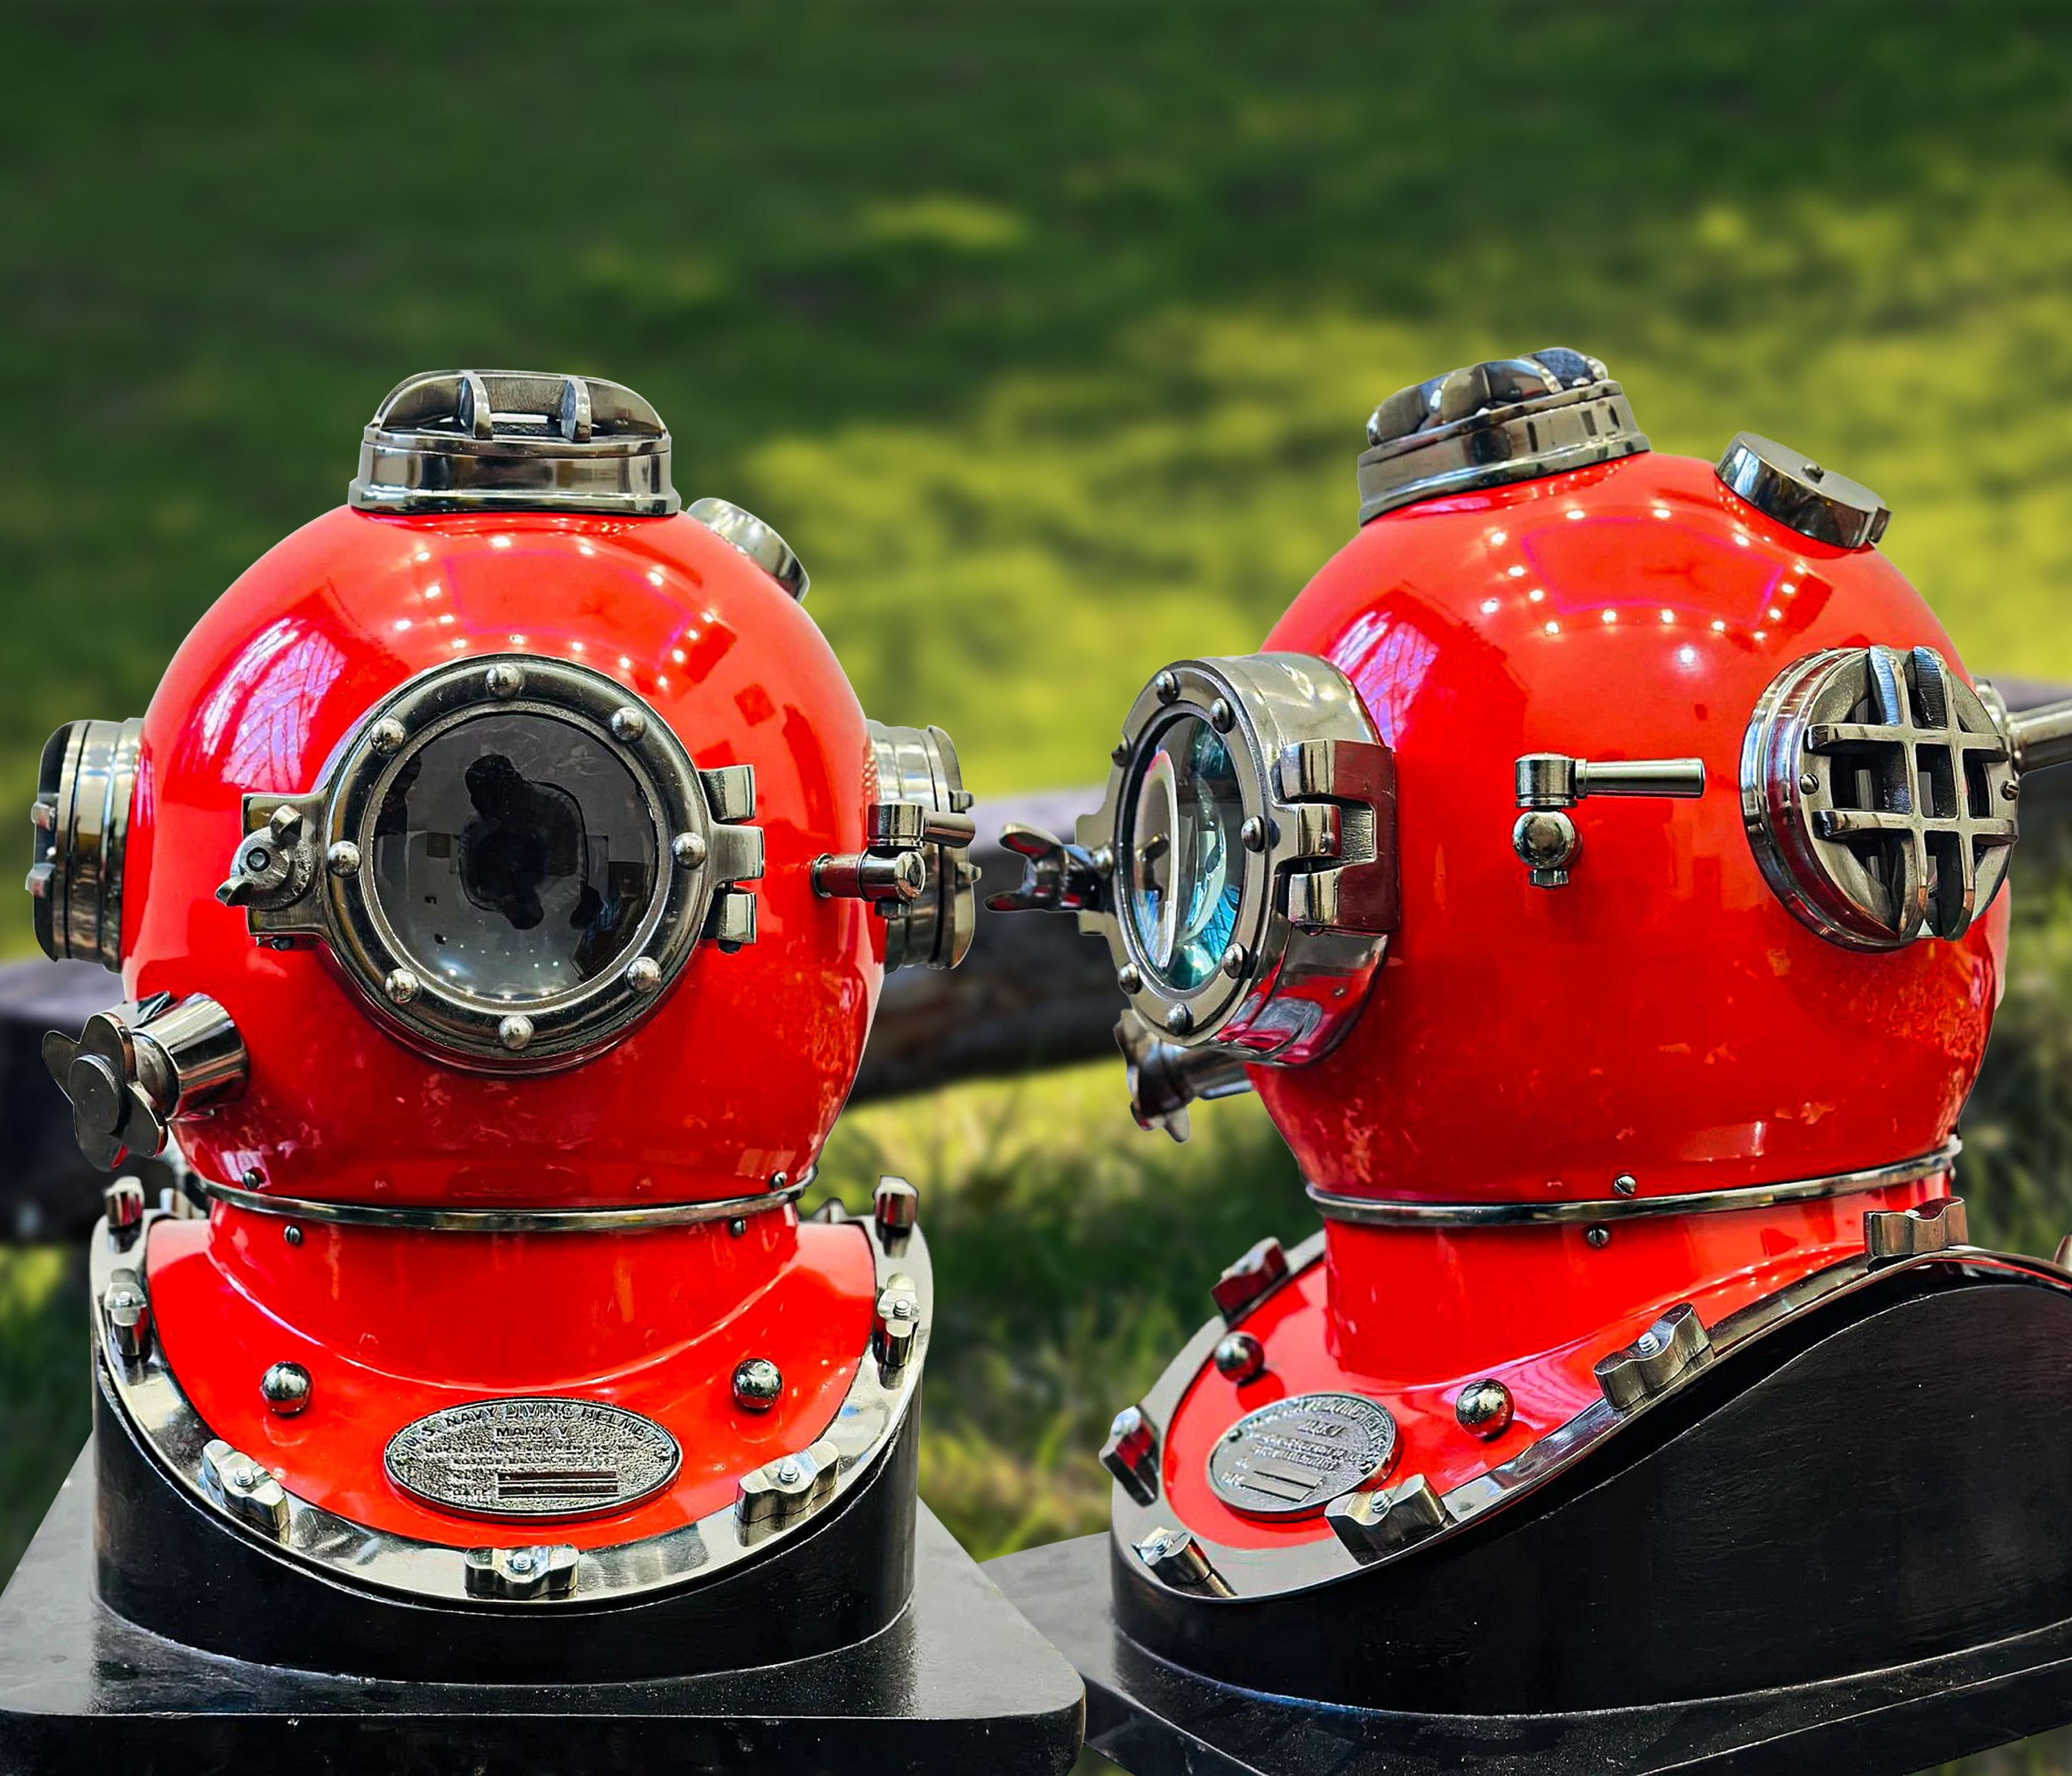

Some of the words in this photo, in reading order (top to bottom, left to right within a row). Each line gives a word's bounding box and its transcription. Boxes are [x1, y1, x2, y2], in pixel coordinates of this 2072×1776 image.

[444, 1406, 495, 1428] NAVY
[506, 1403, 574, 1420] DIVING
[579, 1406, 662, 1447] HELMET
[496, 1426, 550, 1437] MARK
[557, 1426, 568, 1436] V
